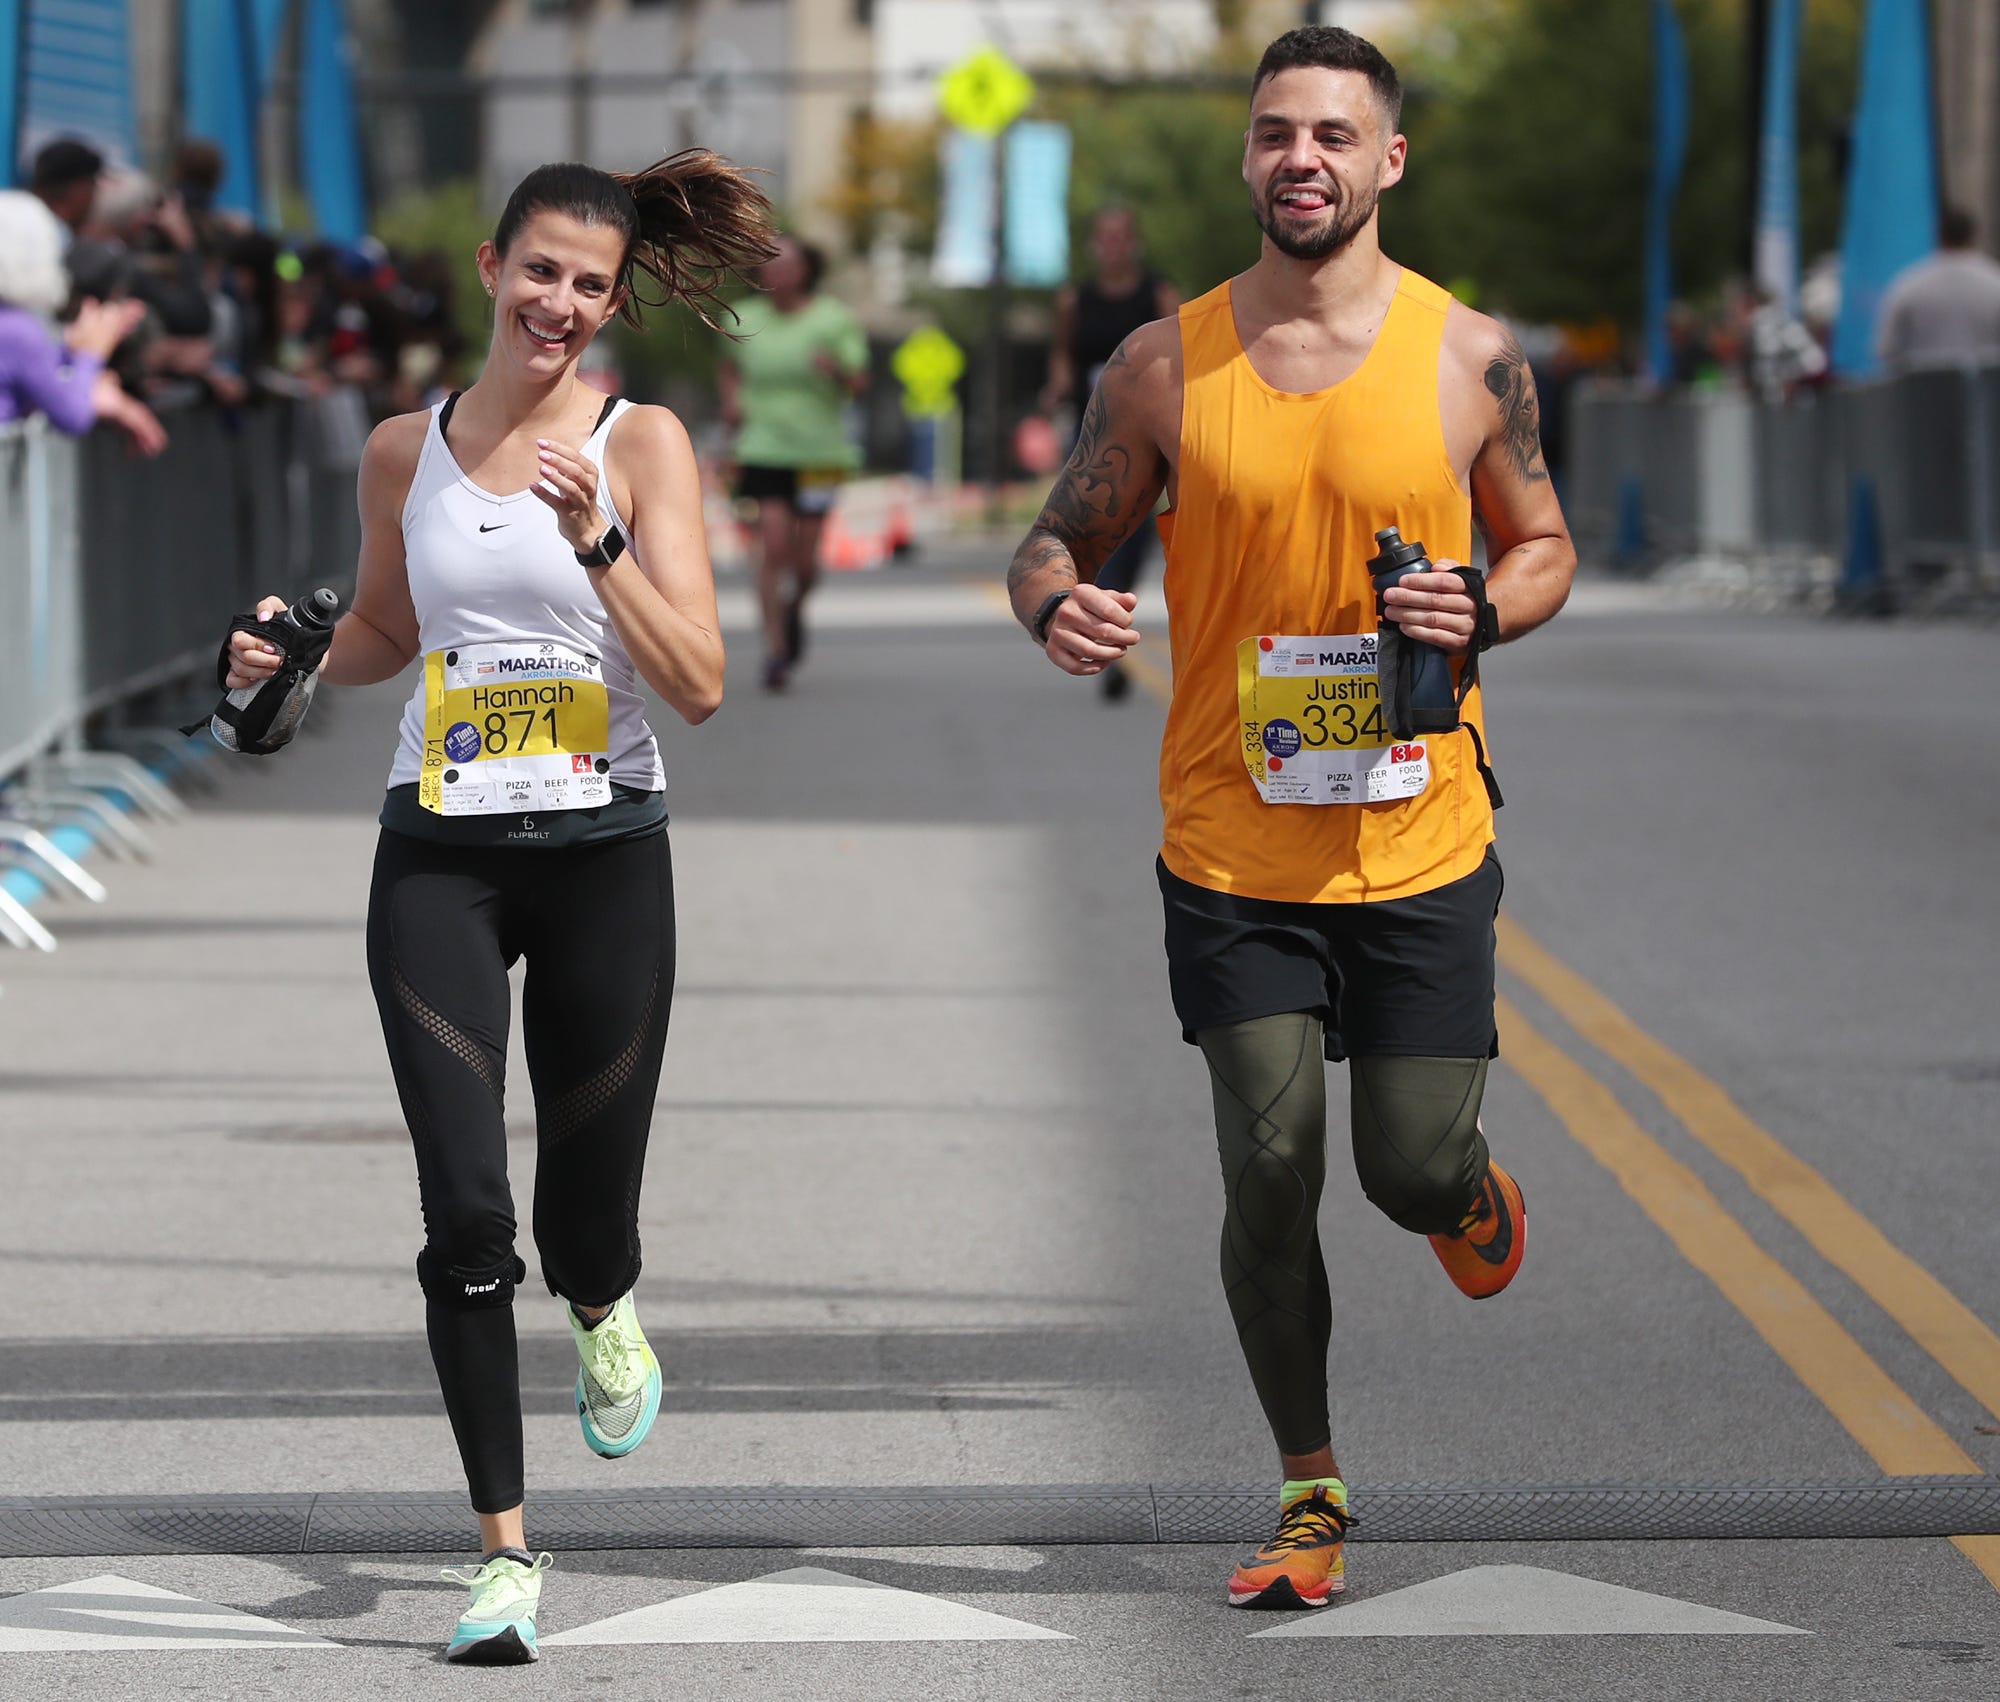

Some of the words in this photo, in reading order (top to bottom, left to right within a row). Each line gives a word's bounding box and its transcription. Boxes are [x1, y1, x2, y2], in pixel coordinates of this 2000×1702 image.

[540, 644, 553, 653] 20
[1360, 637, 1375, 647] 20
[498, 657, 592, 675] MARATHON
[1319, 652, 1377, 665] MARAT
[473, 681, 573, 710] Hannah
[1306, 677, 1379, 701] Justin
[453, 725, 474, 743] Time
[484, 707, 557, 755] 871
[1277, 727, 1298, 739] Time
[1303, 704, 1388, 746] 334
[1245, 720, 1262, 752] 334
[426, 739, 443, 767] 871
[1395, 746, 1406, 762] 3
[576, 759, 587, 771] 4
[1327, 773, 1353, 782] PIZZA
[1364, 769, 1387, 780] BEER
[1399, 764, 1422, 775] FOOD
[422, 777, 430, 801] GEAR
[431, 774, 440, 803] CHECK
[506, 781, 531, 790] PIZZA
[544, 779, 568, 787] BEER
[581, 777, 602, 785] FOOD
[508, 831, 550, 839] FLIPBELT
[465, 1283, 496, 1296] ipow
